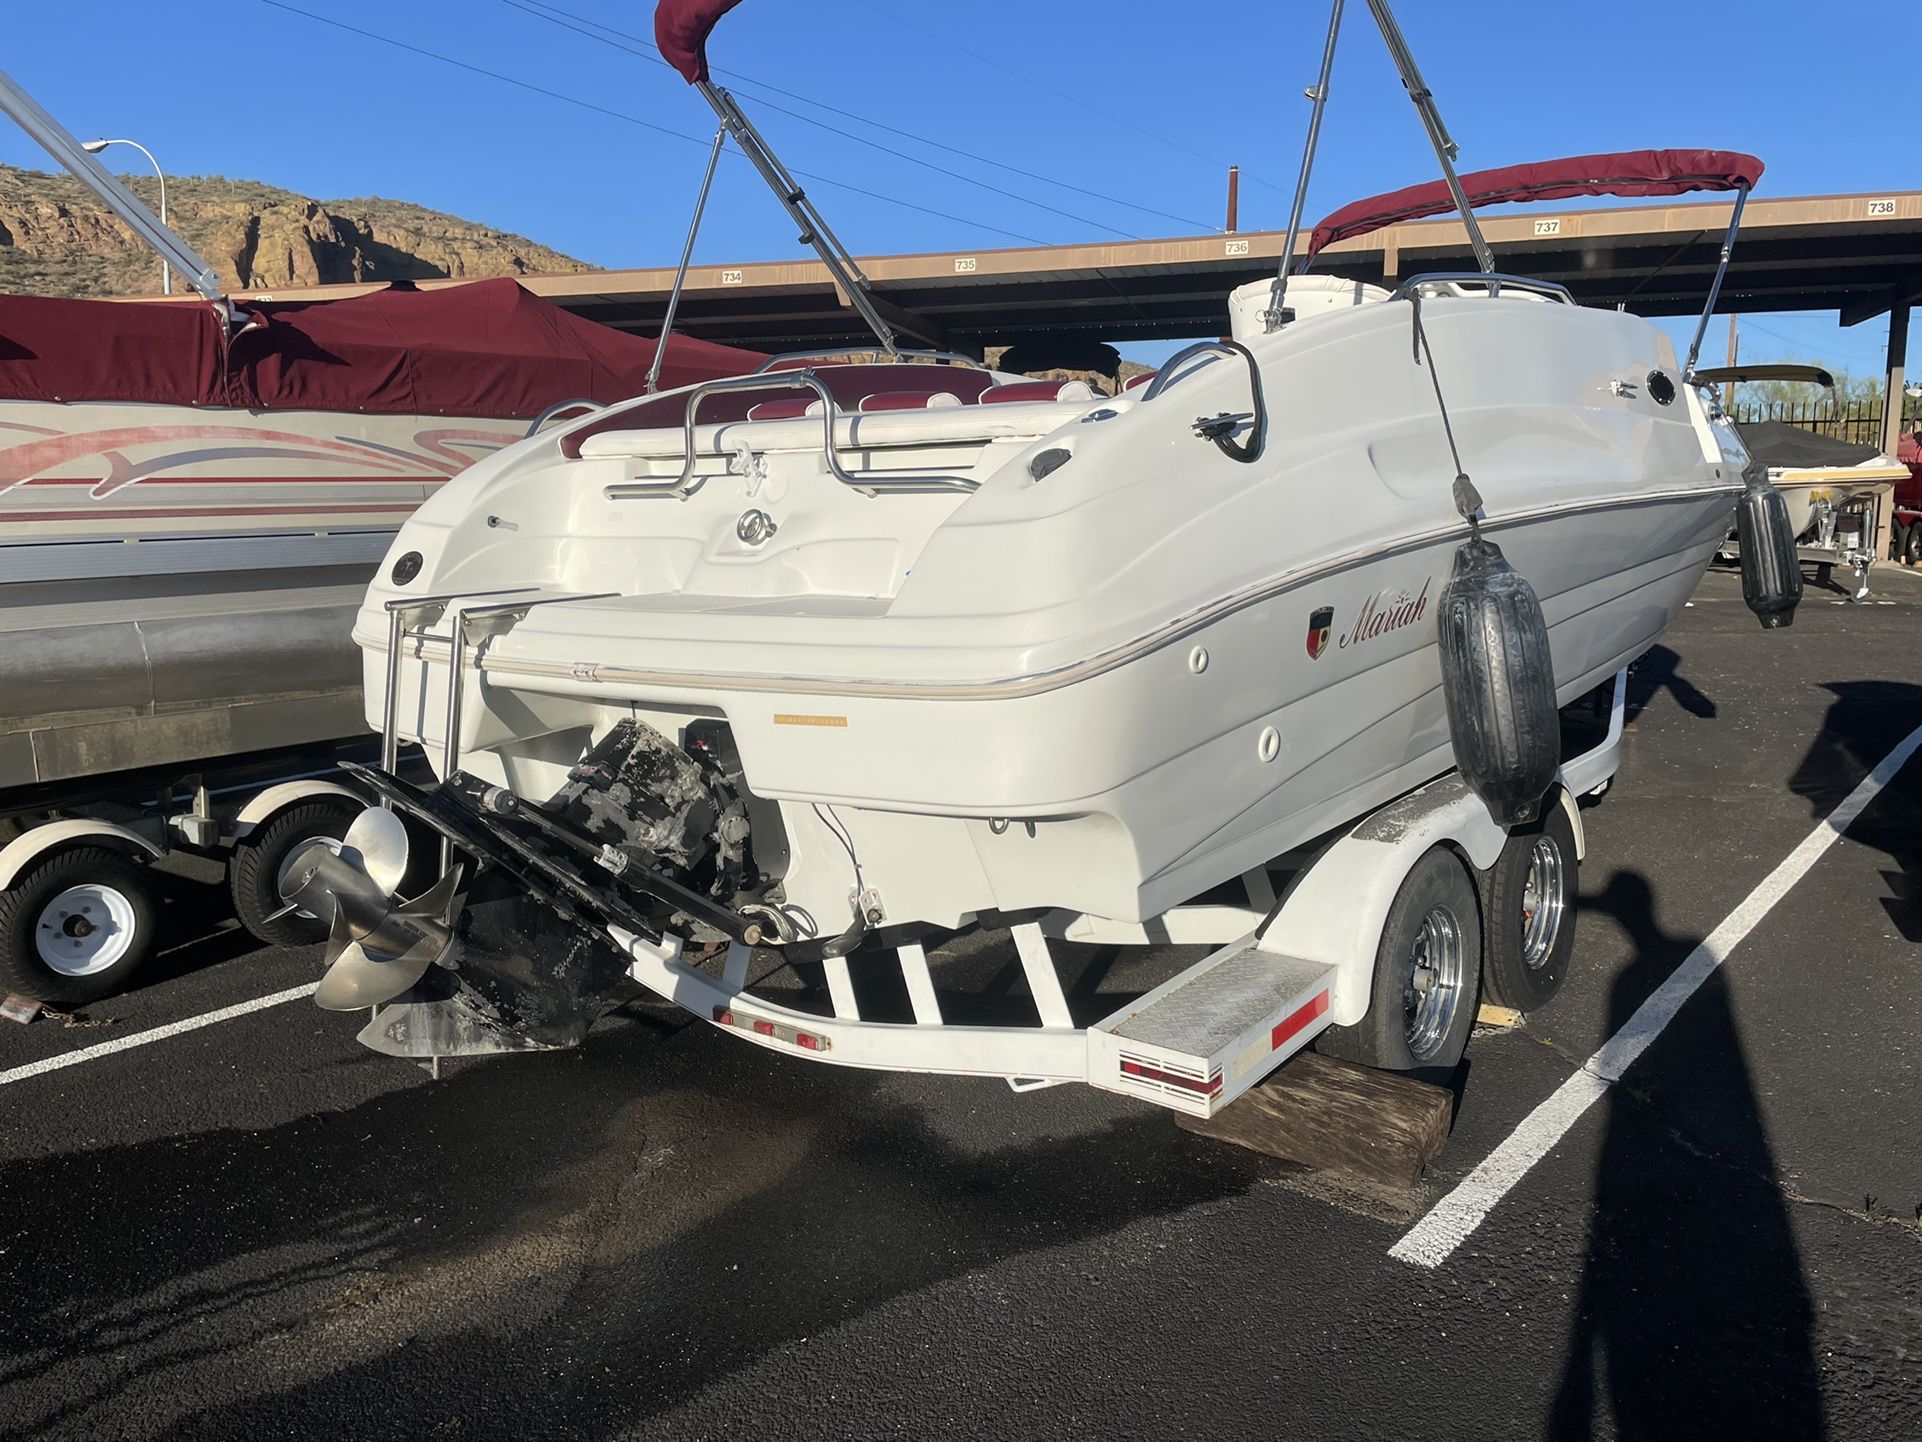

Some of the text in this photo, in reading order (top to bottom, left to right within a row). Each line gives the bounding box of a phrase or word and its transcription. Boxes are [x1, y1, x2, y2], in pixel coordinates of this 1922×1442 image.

[1870, 202, 1894, 213] 738
[1536, 221, 1558, 232] 737
[1227, 243, 1247, 253] 736
[956, 260, 975, 270] 735
[723, 272, 741, 281] 734
[1339, 576, 1432, 649] Mariah
